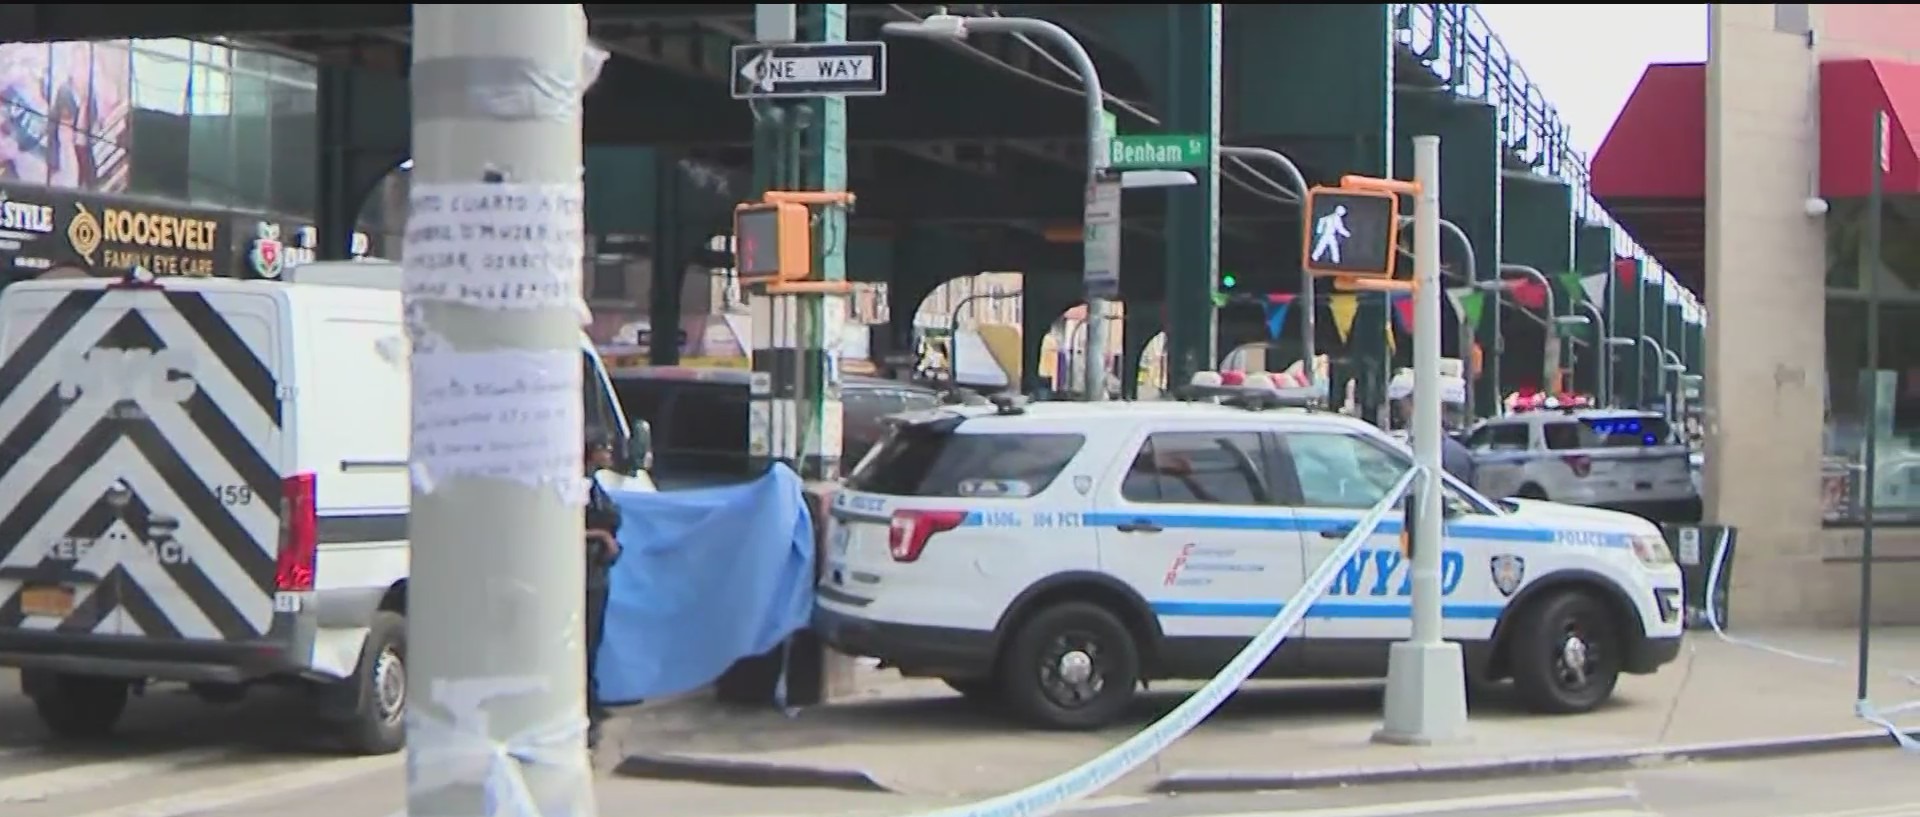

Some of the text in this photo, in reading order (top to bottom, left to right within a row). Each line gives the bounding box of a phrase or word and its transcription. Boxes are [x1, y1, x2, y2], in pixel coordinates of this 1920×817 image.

[755, 59, 862, 80] ONE WAY
[1113, 140, 1182, 163] Benham
[0, 201, 54, 232] STYLE
[104, 208, 217, 252] ROOSEVELT
[153, 254, 178, 274] EYE
[180, 257, 213, 276] CARE
[216, 485, 251, 506] 159
[1328, 549, 1465, 596] NYD
